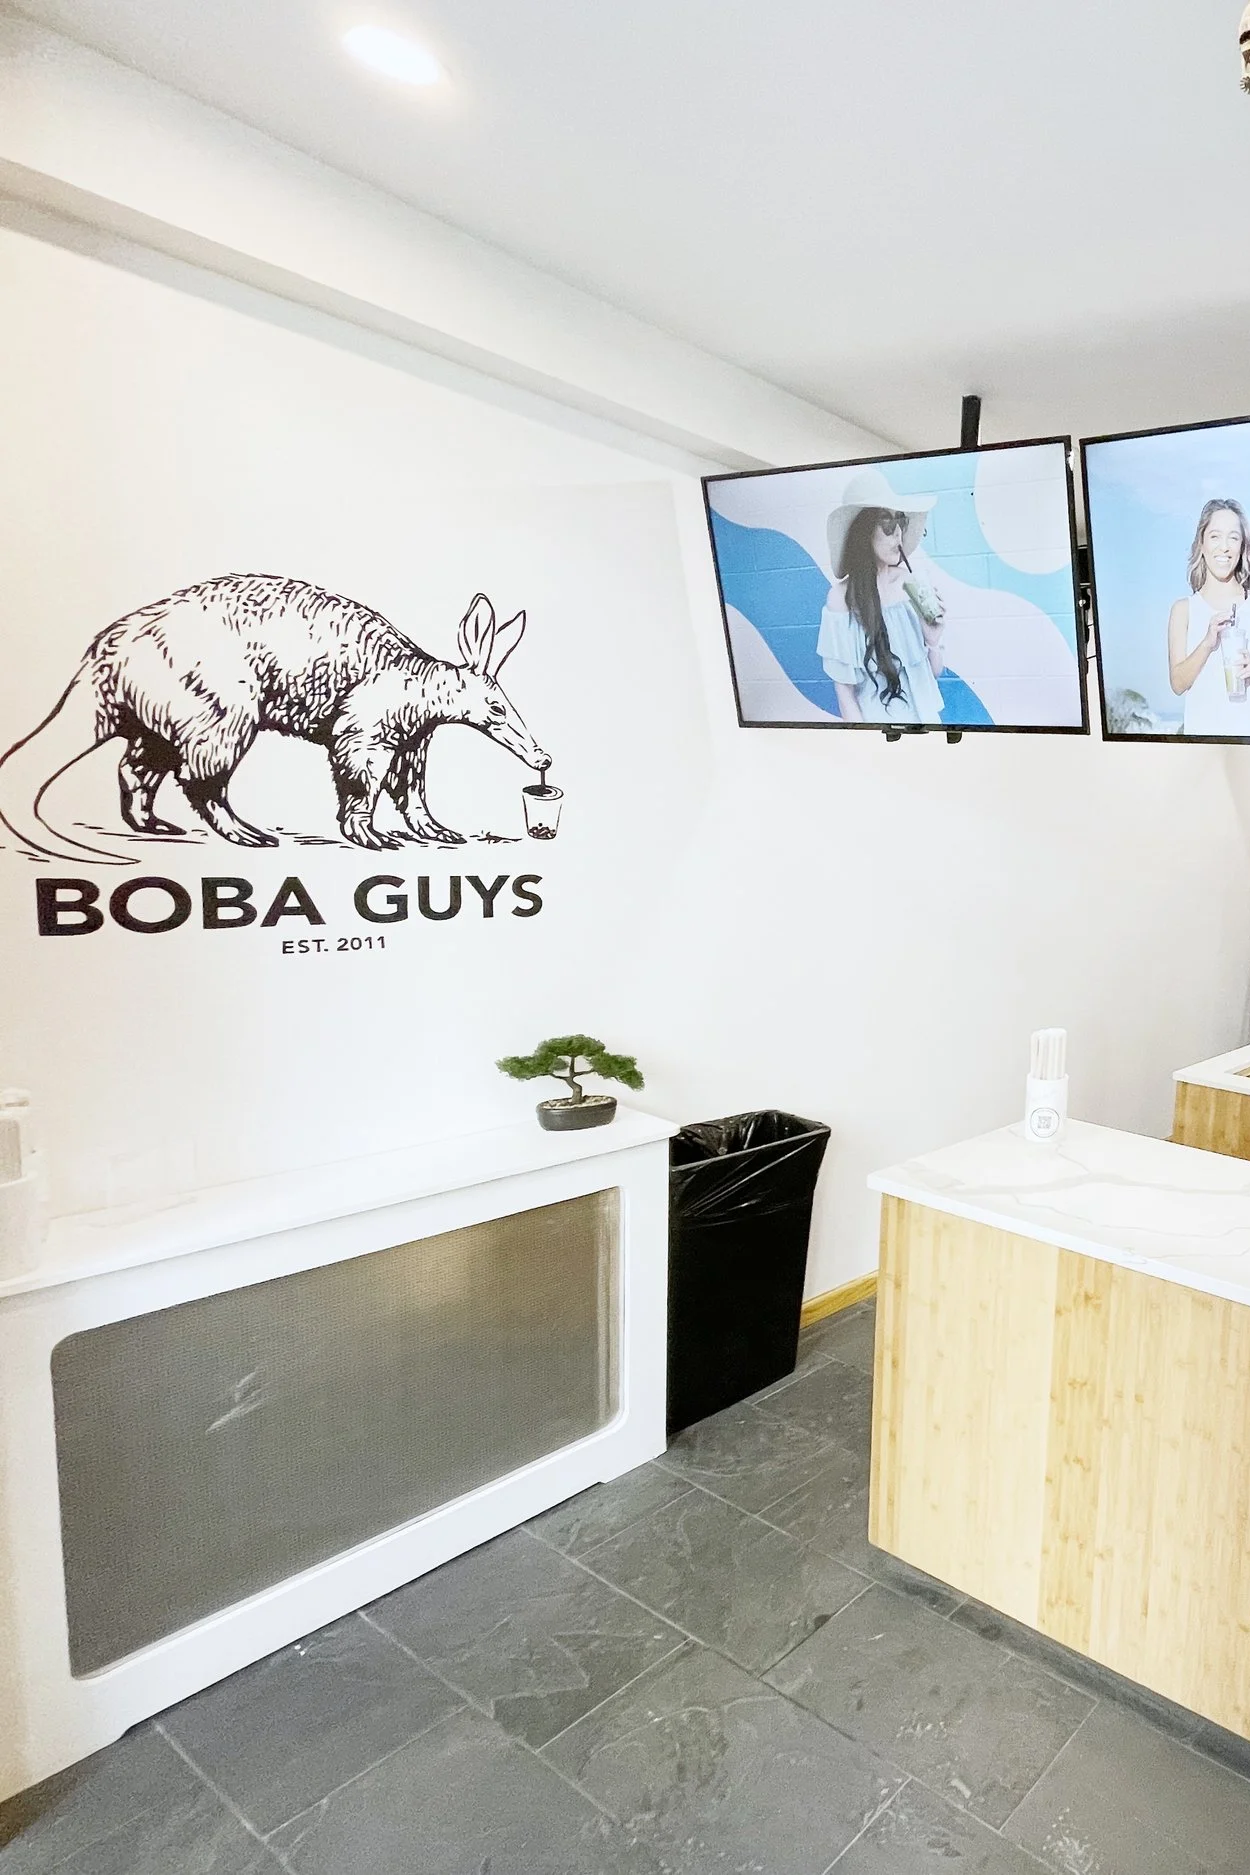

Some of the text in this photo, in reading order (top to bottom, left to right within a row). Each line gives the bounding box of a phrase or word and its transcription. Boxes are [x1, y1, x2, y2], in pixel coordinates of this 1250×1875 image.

[36, 874, 543, 937] BOBA GUYS
[281, 935, 387, 955] EST. 2011
